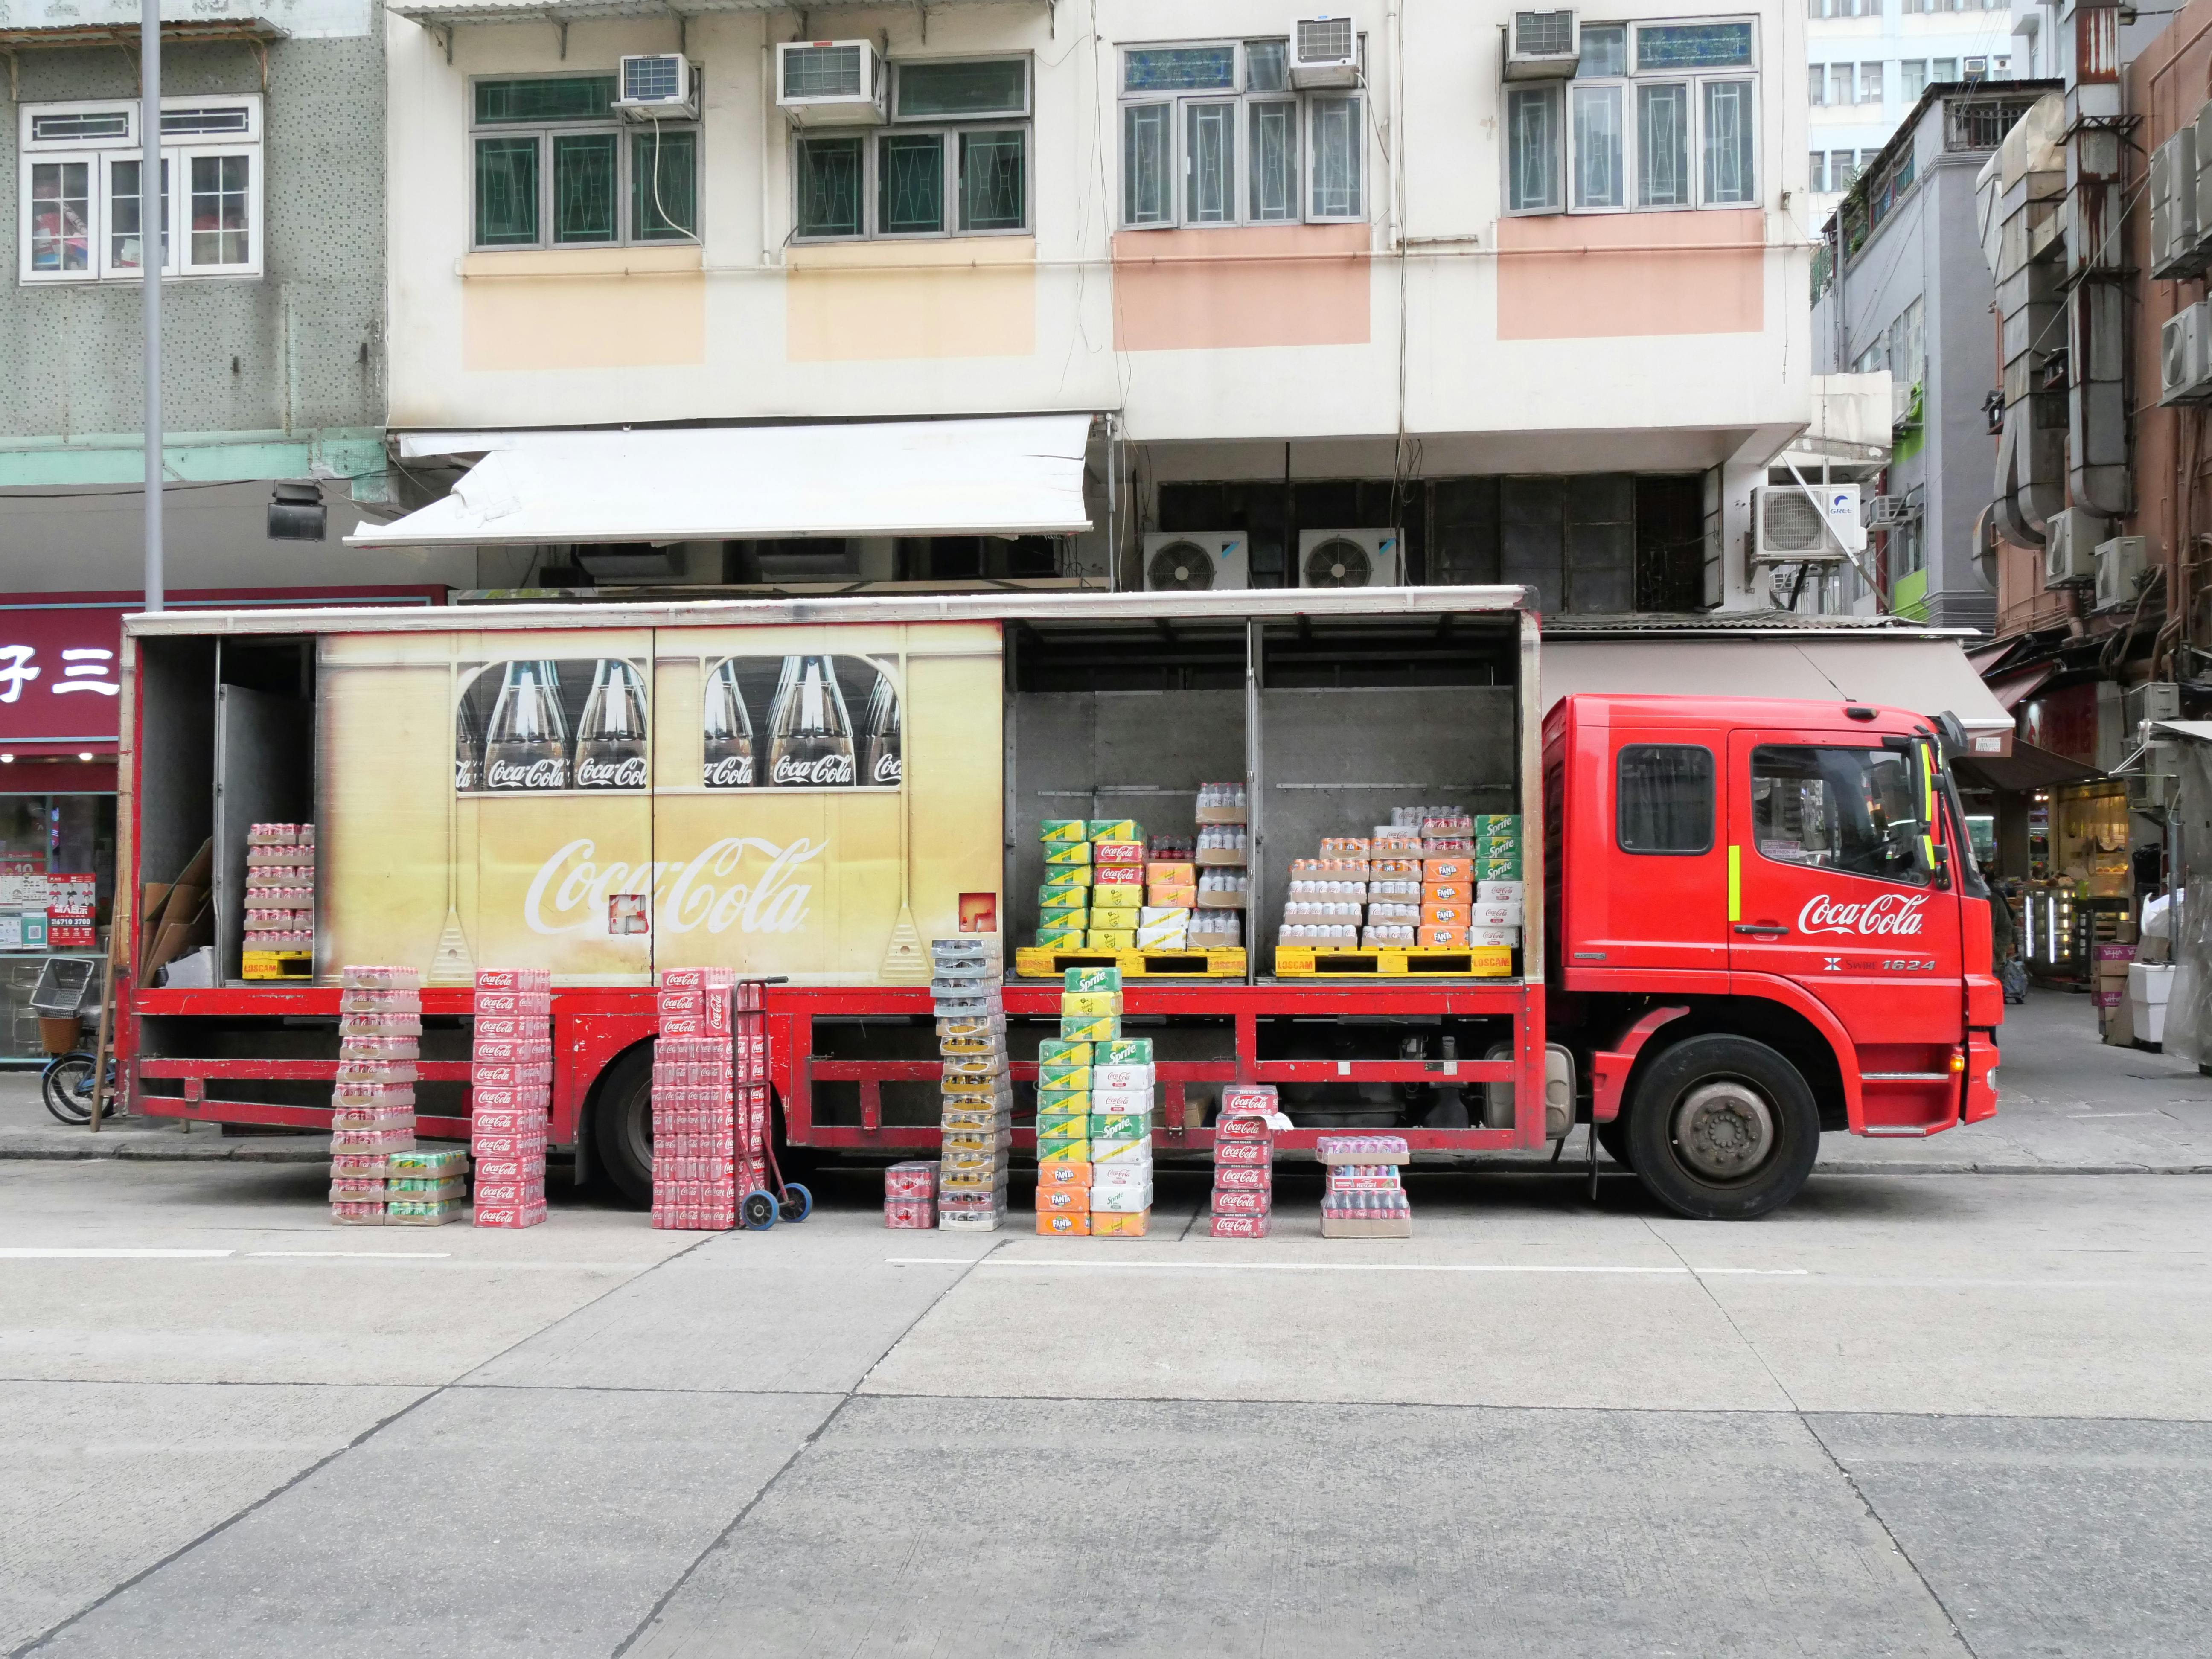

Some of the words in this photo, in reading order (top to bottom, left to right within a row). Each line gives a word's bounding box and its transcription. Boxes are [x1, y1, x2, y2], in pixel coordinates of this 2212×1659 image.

[488, 759, 564, 787] Coca-Cola
[773, 754, 853, 783] Coca-Cola
[1487, 817, 1512, 836] Sprite
[1101, 846, 1135, 857] Coca-Cola
[1489, 839, 1514, 858] Sprite
[1102, 869, 1135, 879] Coca-Cola
[1438, 866, 1457, 874] FANTA
[1487, 862, 1512, 880] Sprite
[524, 838, 830, 934] Coca-Cola
[1437, 890, 1455, 898] FANTA
[1437, 911, 1455, 920] FANTA
[1798, 894, 1930, 934] Coca-Cola
[1434, 933, 1452, 941] FANTA
[1278, 961, 1313, 969] LOSCAM
[1473, 958, 1509, 966] LOSCAM
[1882, 960, 1935, 970] 1624
[479, 973, 514, 986] Coca-Cola
[667, 973, 700, 986] Coca-Cola
[1079, 972, 1106, 991] Sprite
[480, 997, 515, 1010] Coca-Cola
[662, 997, 694, 1009] Coca-Cola
[711, 993, 722, 1029] Coca-Cola
[480, 1021, 515, 1033] Coca-Cola
[664, 1020, 696, 1033] Coca-Cola
[479, 1044, 514, 1057] Coca-Cola
[1109, 1045, 1136, 1065] Sprite
[477, 1068, 511, 1080] Coca-Cola
[1108, 1072, 1130, 1080] Coca-Cola
[478, 1091, 512, 1103] Coca-Cola
[1231, 1096, 1269, 1109] Coca-Cola
[478, 1115, 514, 1127] Coca-Cola
[1103, 1118, 1132, 1138] Sprite
[1224, 1121, 1261, 1134] Coca-Cola
[477, 1139, 512, 1151] Coca-Cola
[1222, 1145, 1259, 1158] Coca-Cola
[482, 1163, 519, 1175] Coca-Cola
[1055, 1170, 1074, 1179] FANTA
[1107, 1169, 1130, 1177] Coca-Cola
[1223, 1170, 1260, 1182] Coca-Cola
[480, 1186, 516, 1199] Coca-Cola
[1107, 1192, 1123, 1205] Sprite
[1052, 1195, 1070, 1203] FANTA
[1220, 1194, 1257, 1207] Coca-Cola
[480, 1210, 515, 1222] Coca-Cola
[1053, 1219, 1071, 1228] FANTA
[1217, 1219, 1254, 1231] Coca-Cola
